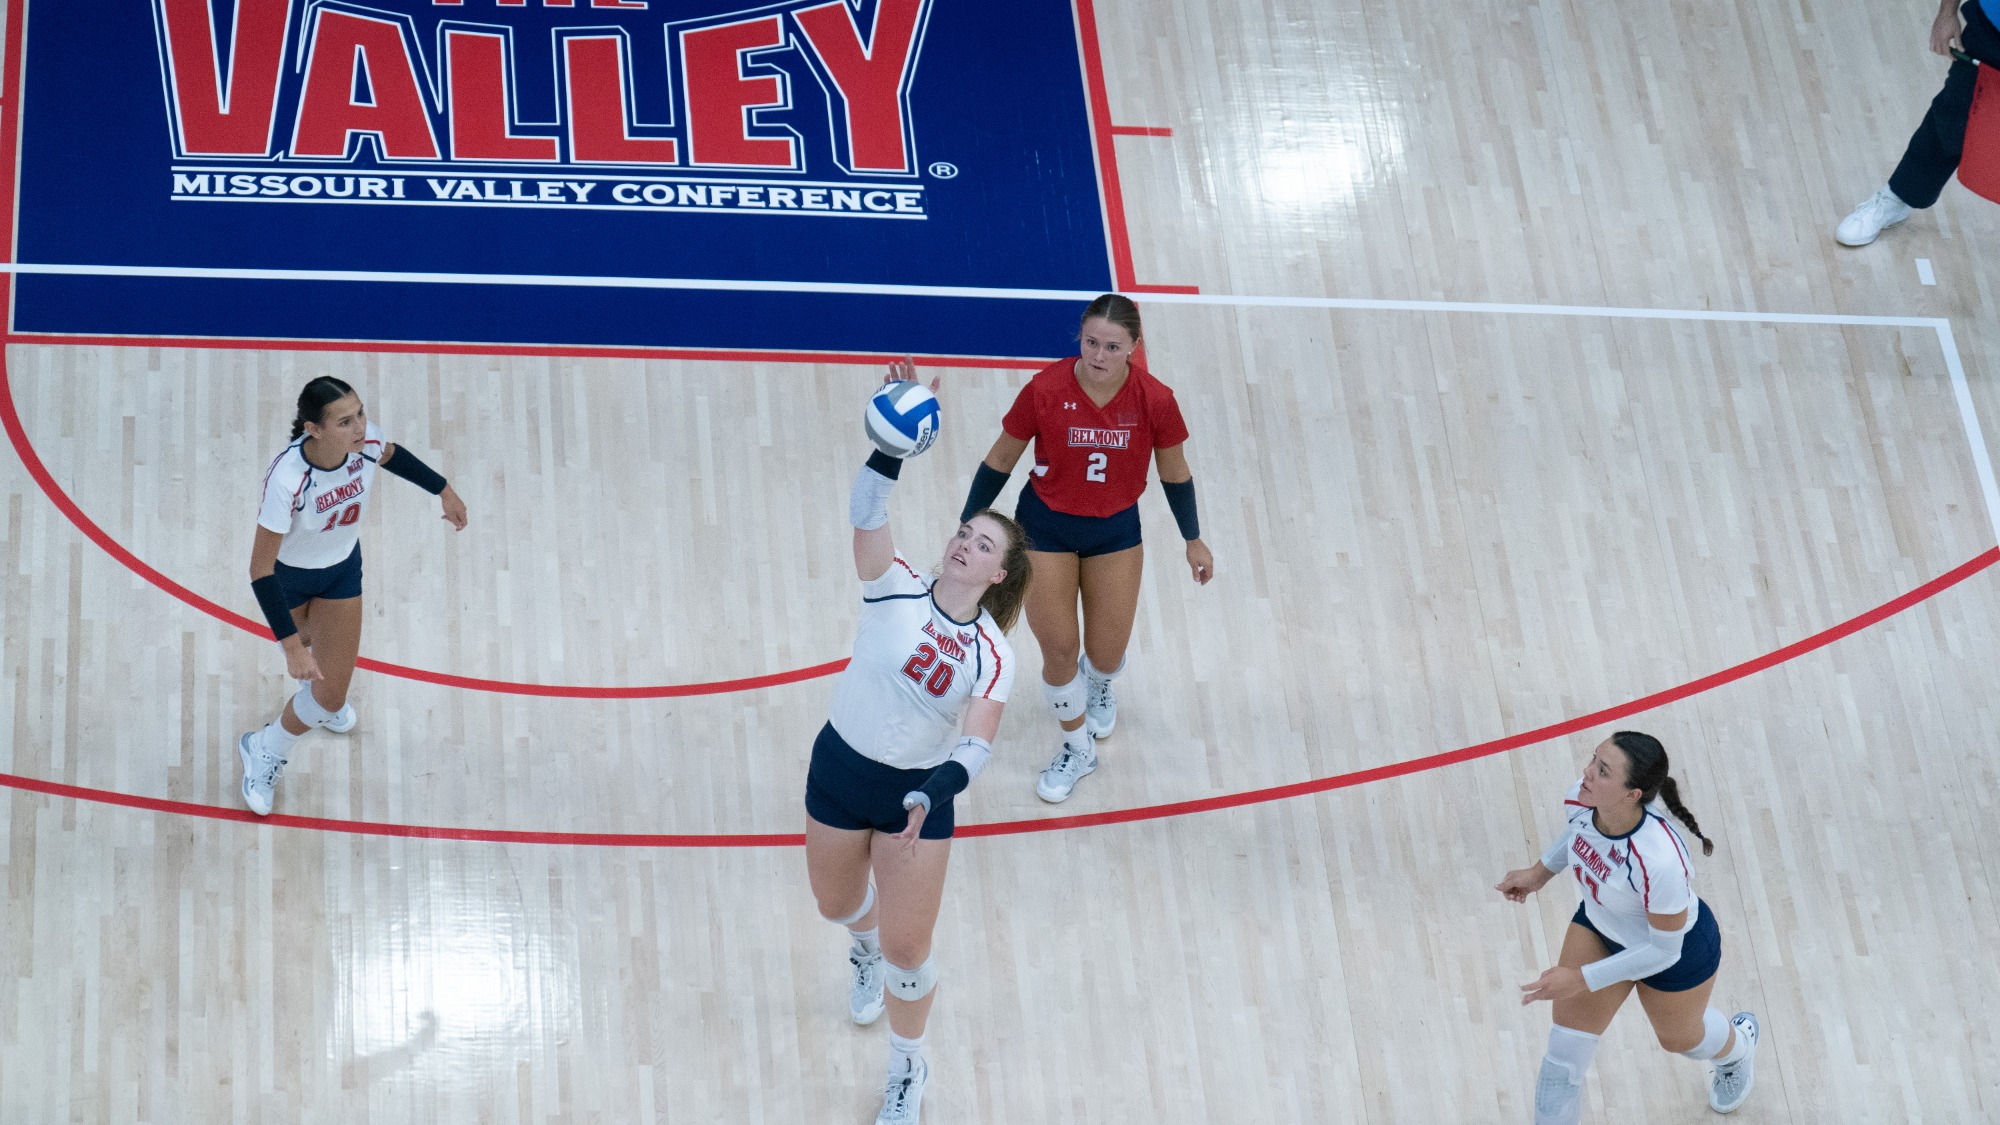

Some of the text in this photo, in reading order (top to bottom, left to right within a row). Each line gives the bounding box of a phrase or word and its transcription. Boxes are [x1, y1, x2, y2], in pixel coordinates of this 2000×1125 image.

[154, 0, 928, 177] VALLEY
[172, 173, 924, 214] MISSOURI VALLEY CONFERENCE
[1070, 428, 1129, 447] BELMONT
[1086, 452, 1108, 483] 2
[316, 477, 363, 512] BELMONT
[320, 501, 361, 532] 10
[923, 620, 966, 664] MONT
[900, 642, 955, 698] 20
[1572, 834, 1612, 883] BELMONT
[1573, 864, 1604, 907] 17
